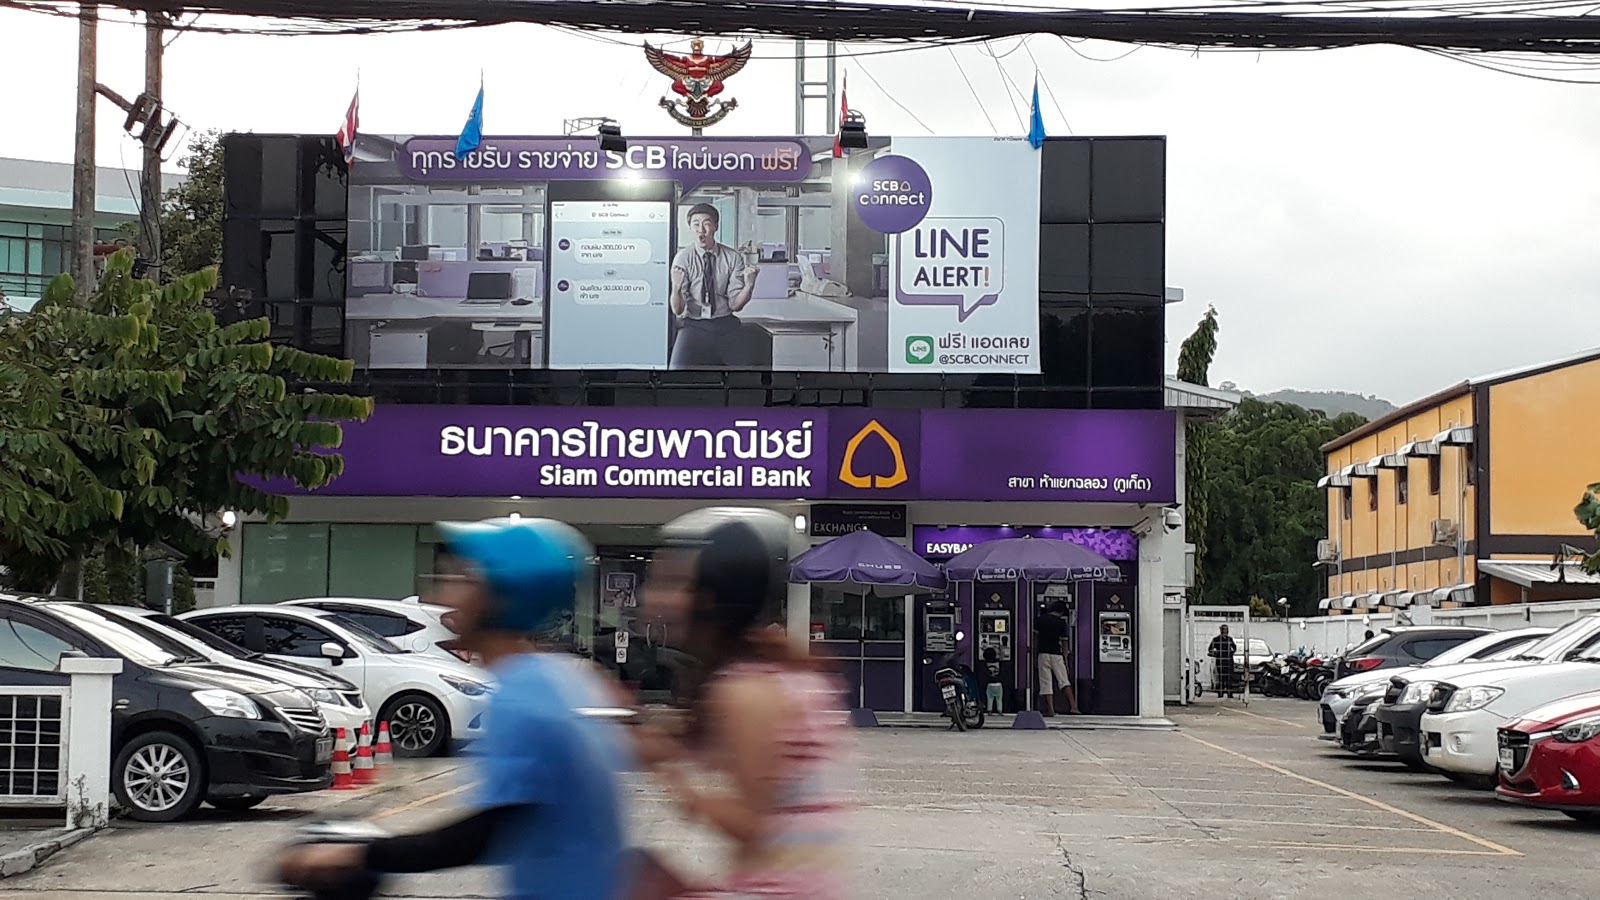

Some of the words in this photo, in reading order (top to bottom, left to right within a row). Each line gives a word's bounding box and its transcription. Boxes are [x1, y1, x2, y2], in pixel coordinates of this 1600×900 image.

[518, 144, 598, 169] รายจ่าย
[605, 145, 666, 169] SCB
[670, 145, 754, 170] ไลน์บอก
[761, 147, 800, 170] ฟรี!
[873, 181, 899, 191] SCB
[860, 192, 925, 205] connect
[915, 228, 989, 258] LINE
[913, 266, 989, 287] ALERT!
[939, 332, 966, 348] ฟรี!
[971, 337, 1030, 349] แอดเลย
[939, 354, 1030, 365] @SCBCONNECT
[440, 420, 813, 459] ธนาคารไทยพาณิชย์
[540, 464, 598, 486] Siam
[604, 465, 743, 487] Commercial
[751, 466, 812, 487] Bank
[1008, 477, 1035, 488] สาขา
[1040, 474, 1108, 489] ห้าแยกฉลอง
[1113, 474, 1152, 493] (ภูเก็ต)
[926, 543, 973, 554] EASYBA
